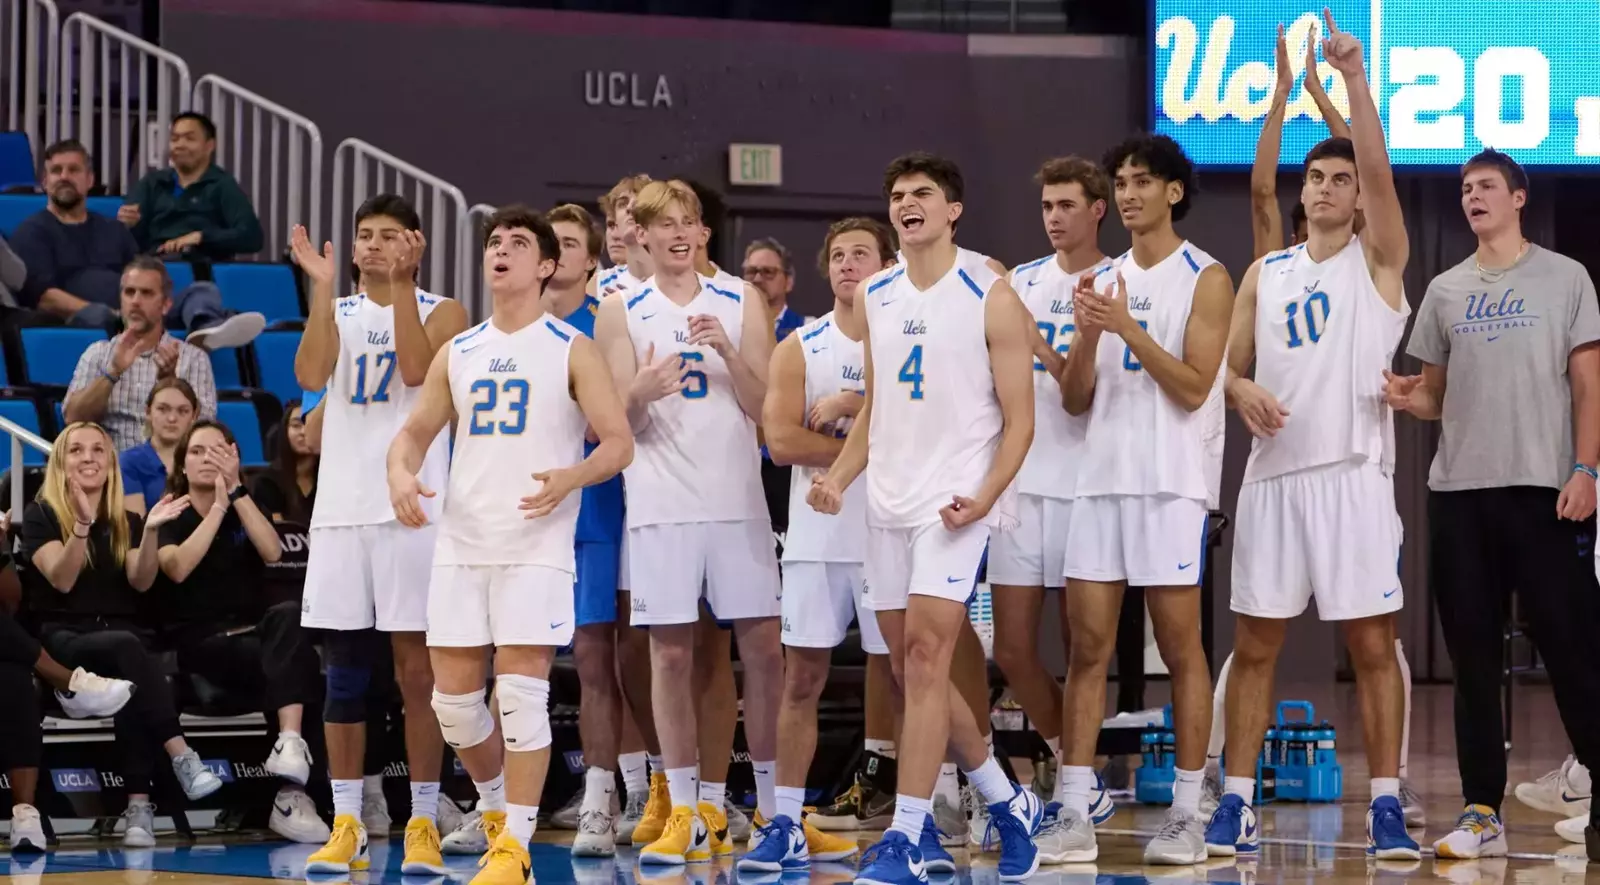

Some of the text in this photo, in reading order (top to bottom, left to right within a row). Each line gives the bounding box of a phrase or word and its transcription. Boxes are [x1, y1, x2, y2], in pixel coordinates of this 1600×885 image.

[585, 70, 673, 107] UCLA
[1389, 46, 1550, 149] 20
[740, 148, 771, 180] EXIT
[1130, 296, 1152, 311] Ucla
[1284, 291, 1331, 348] 10
[1465, 288, 1526, 321] Ucla
[902, 319, 927, 335] Ucla
[1454, 320, 1536, 335] VOLLEYBALL
[350, 350, 398, 405] 17
[488, 357, 519, 373] Ucla
[898, 344, 924, 401] 4
[469, 378, 531, 437] 23
[58, 773, 94, 787] UCLA
